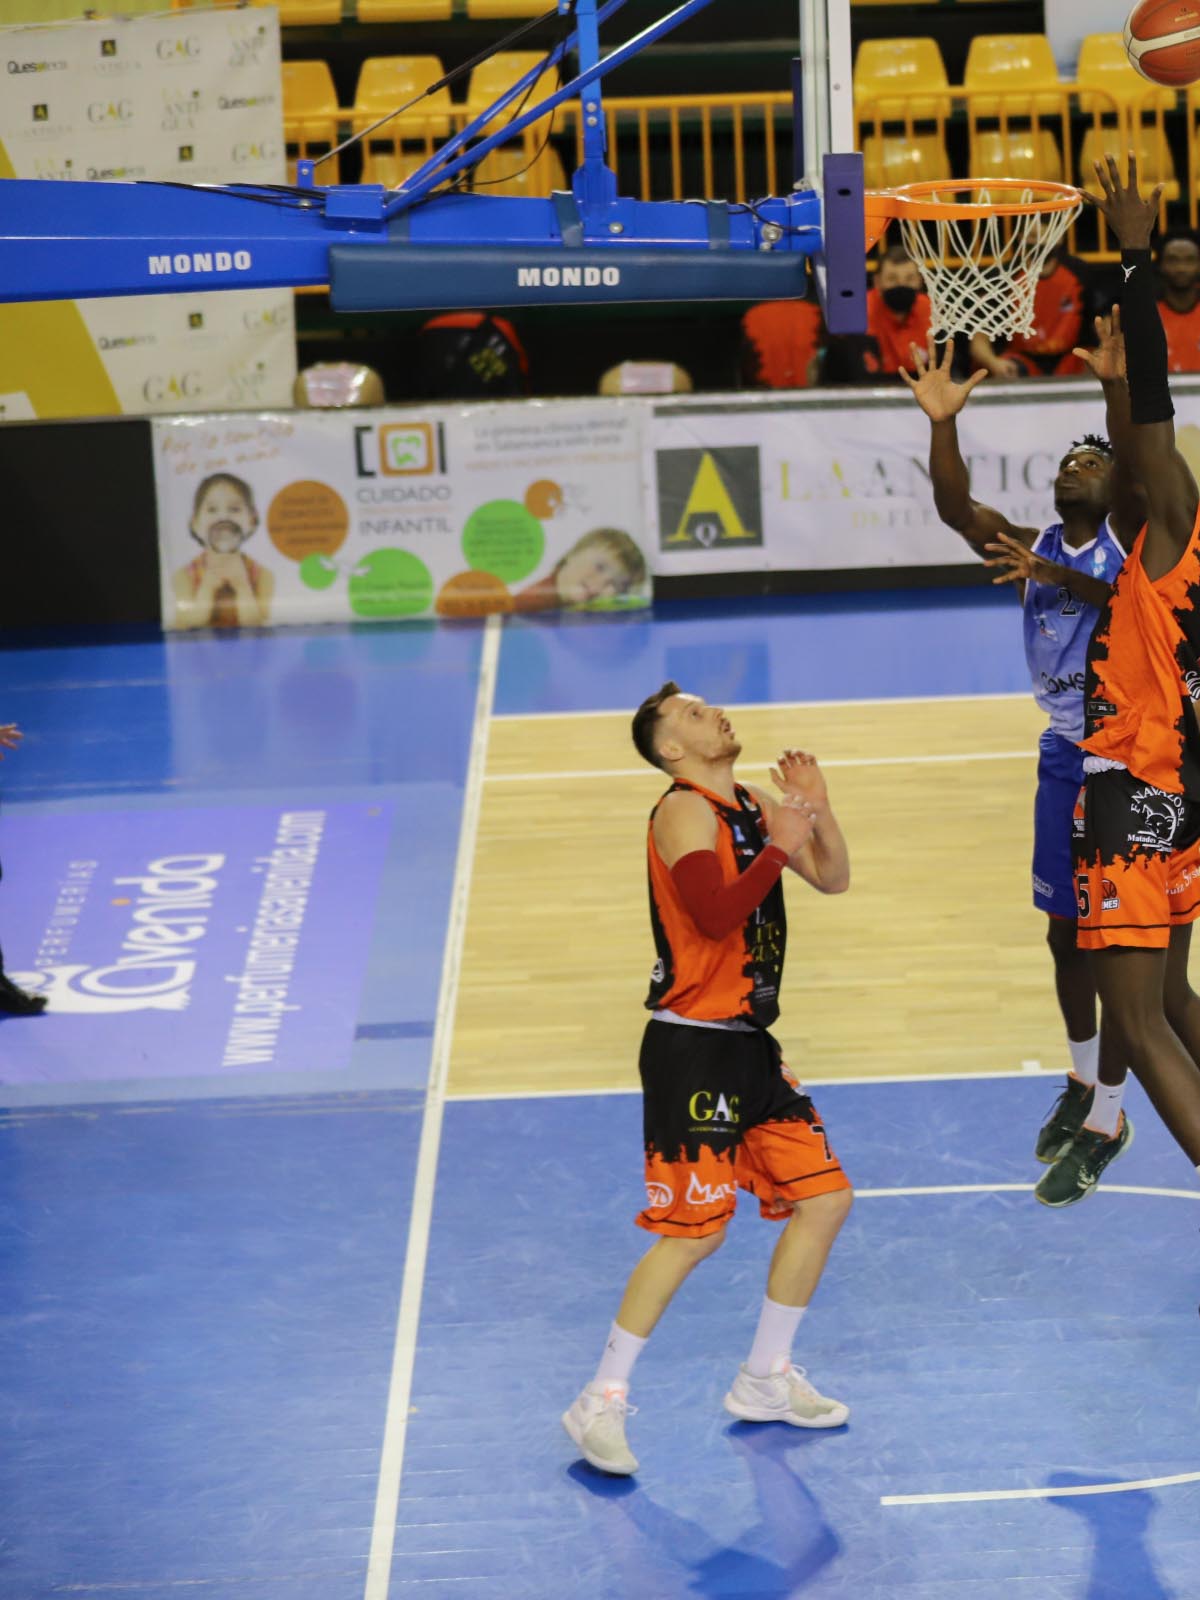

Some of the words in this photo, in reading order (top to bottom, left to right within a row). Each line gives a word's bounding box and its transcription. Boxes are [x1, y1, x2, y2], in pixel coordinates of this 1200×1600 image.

[148, 251, 252, 275] MONDO
[518, 267, 620, 287] MONDO
[357, 486, 452, 504] CUIDADO
[359, 516, 454, 536] INFANTIL
